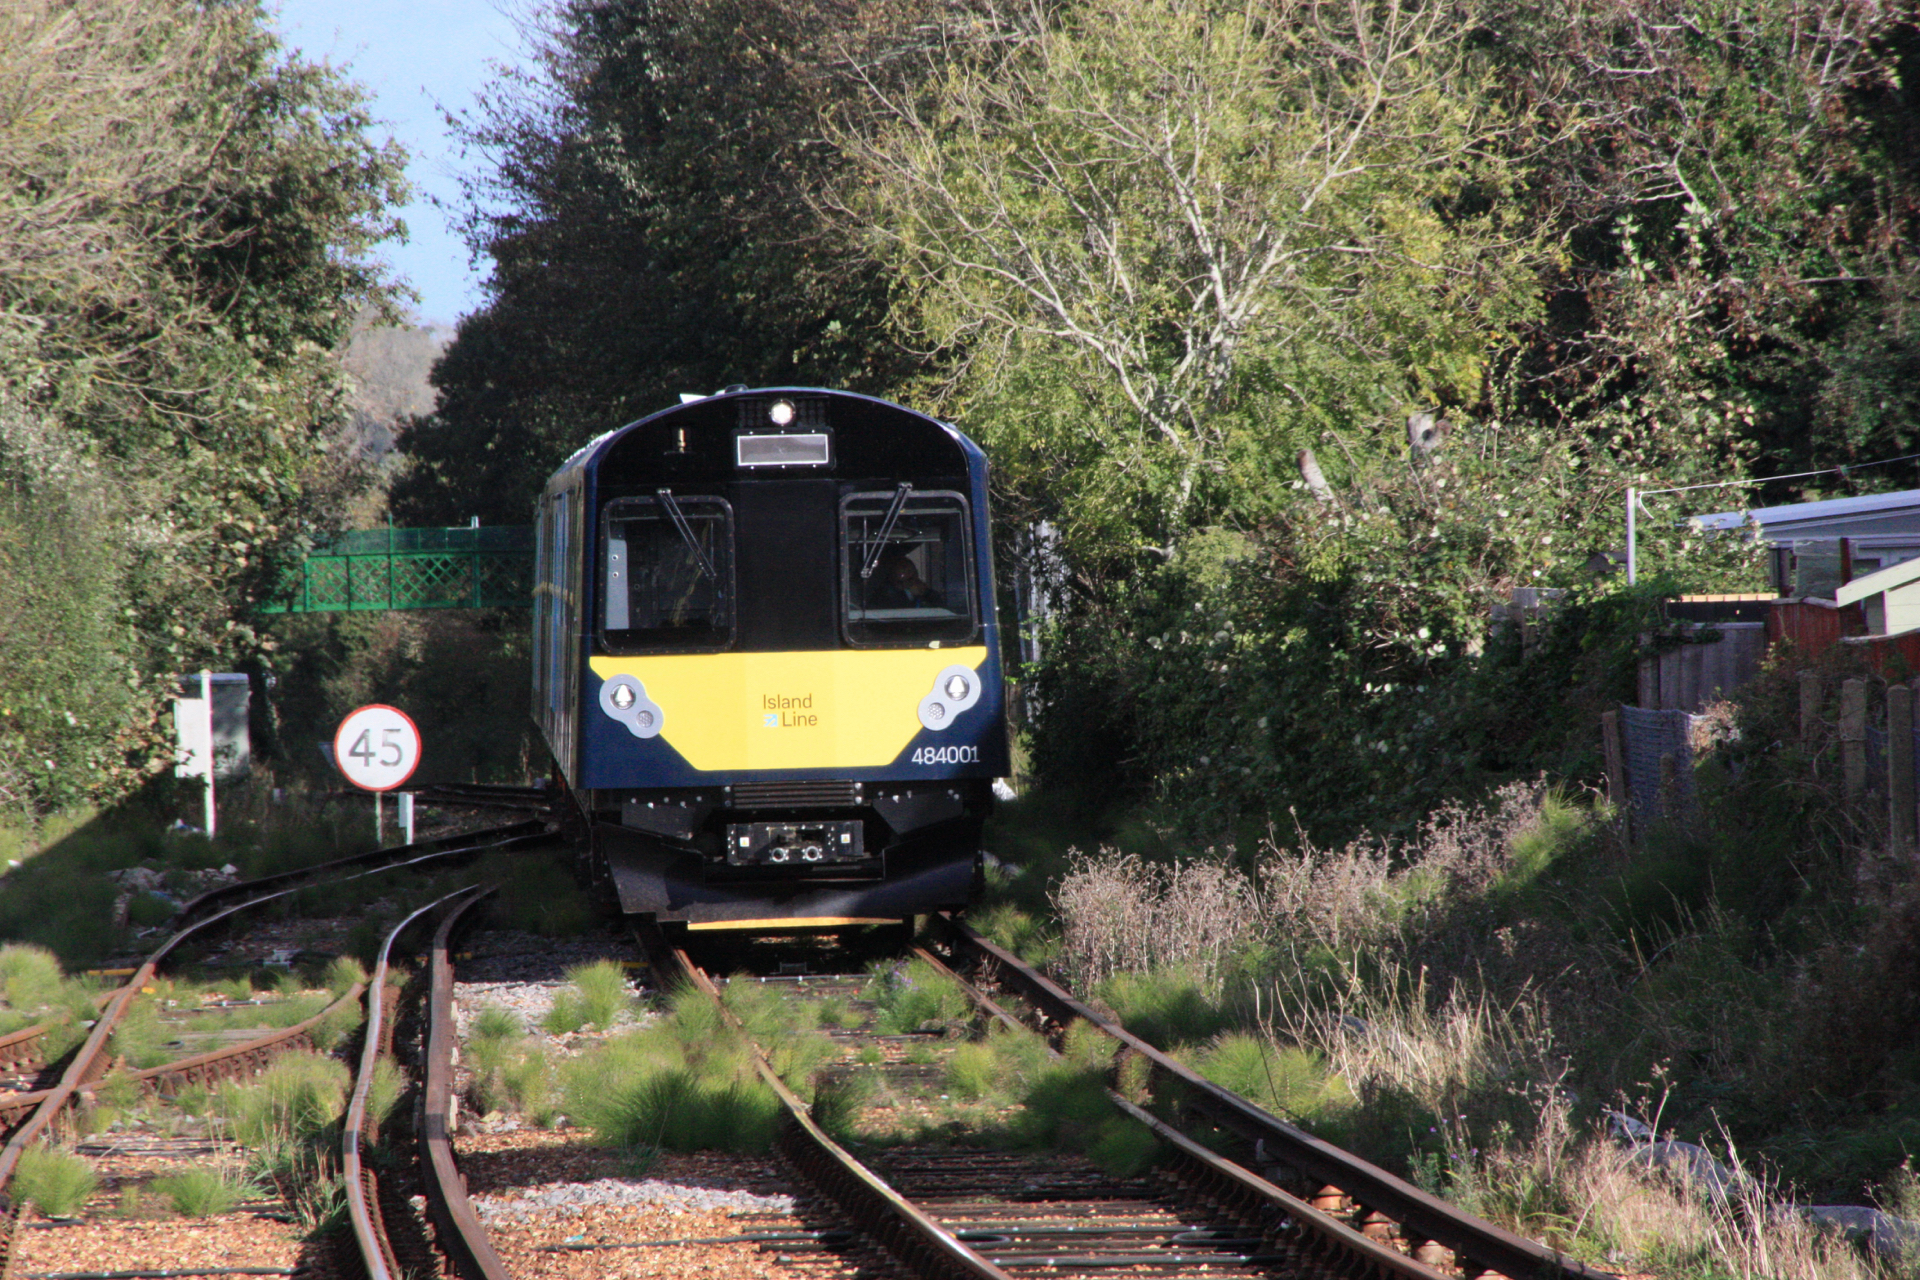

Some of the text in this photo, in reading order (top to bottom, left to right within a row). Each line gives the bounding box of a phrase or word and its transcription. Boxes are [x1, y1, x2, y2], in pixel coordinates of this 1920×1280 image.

[763, 693, 813, 709] Island
[782, 712, 818, 727] Line
[348, 728, 403, 767] 45
[911, 746, 980, 765] 484001
